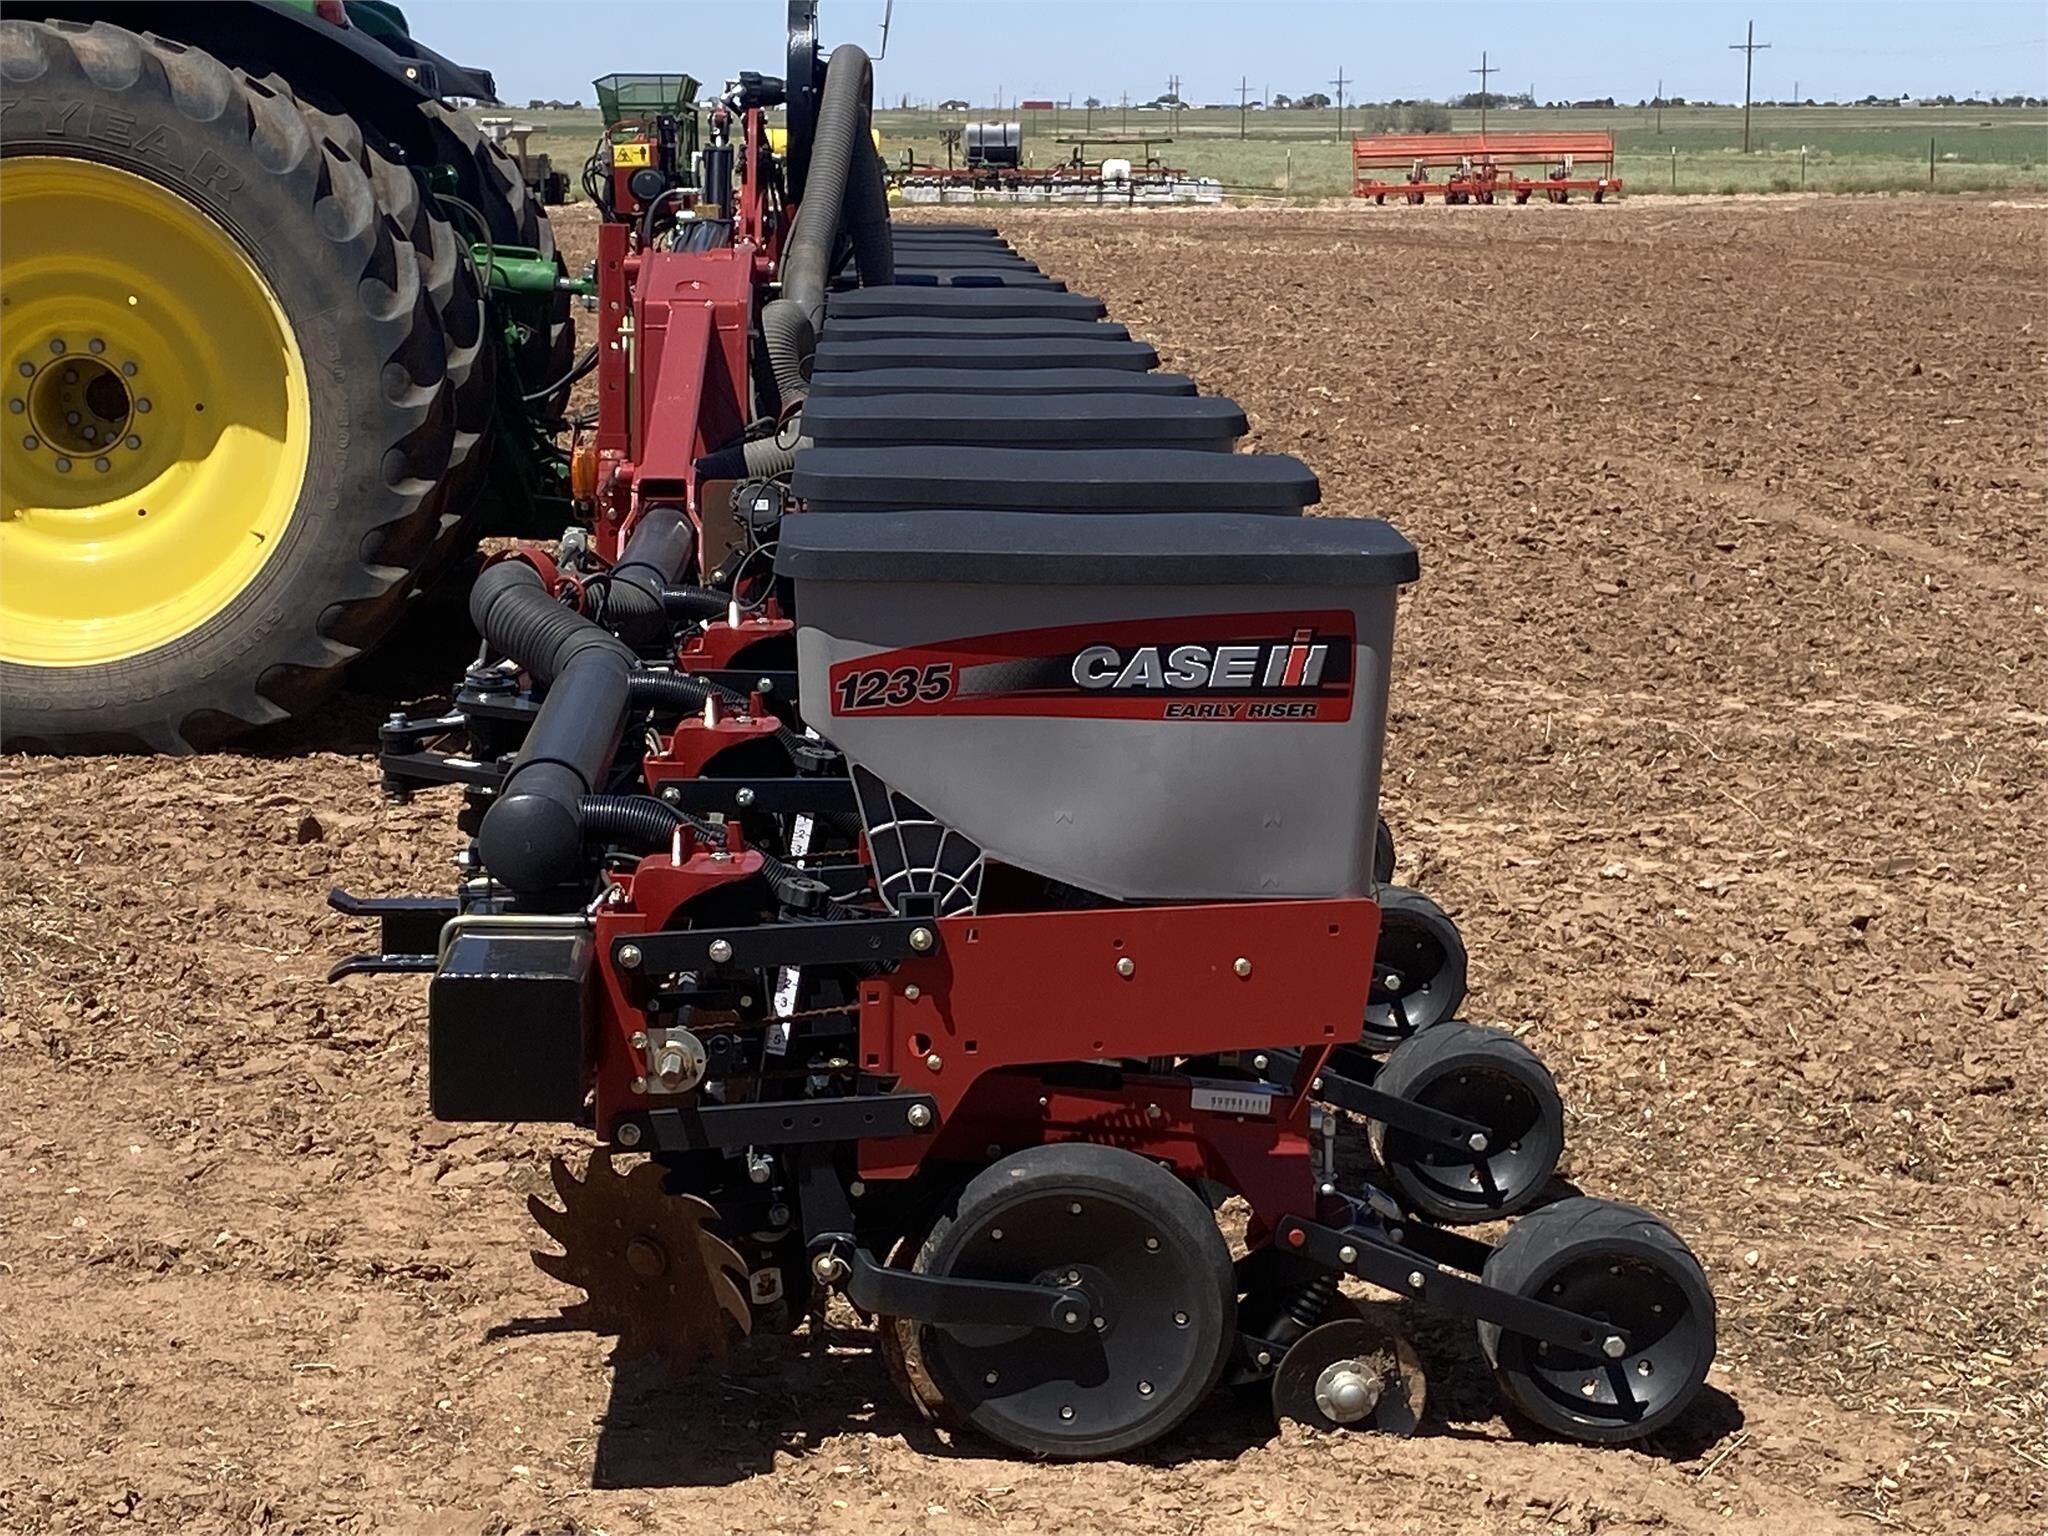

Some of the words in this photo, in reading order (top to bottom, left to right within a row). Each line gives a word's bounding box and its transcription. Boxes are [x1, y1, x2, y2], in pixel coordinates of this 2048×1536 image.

[835, 663, 953, 712] 1235
[1072, 645, 1260, 689] CASE
[1164, 702, 1244, 719] EARLY
[1246, 702, 1318, 719] RISER
